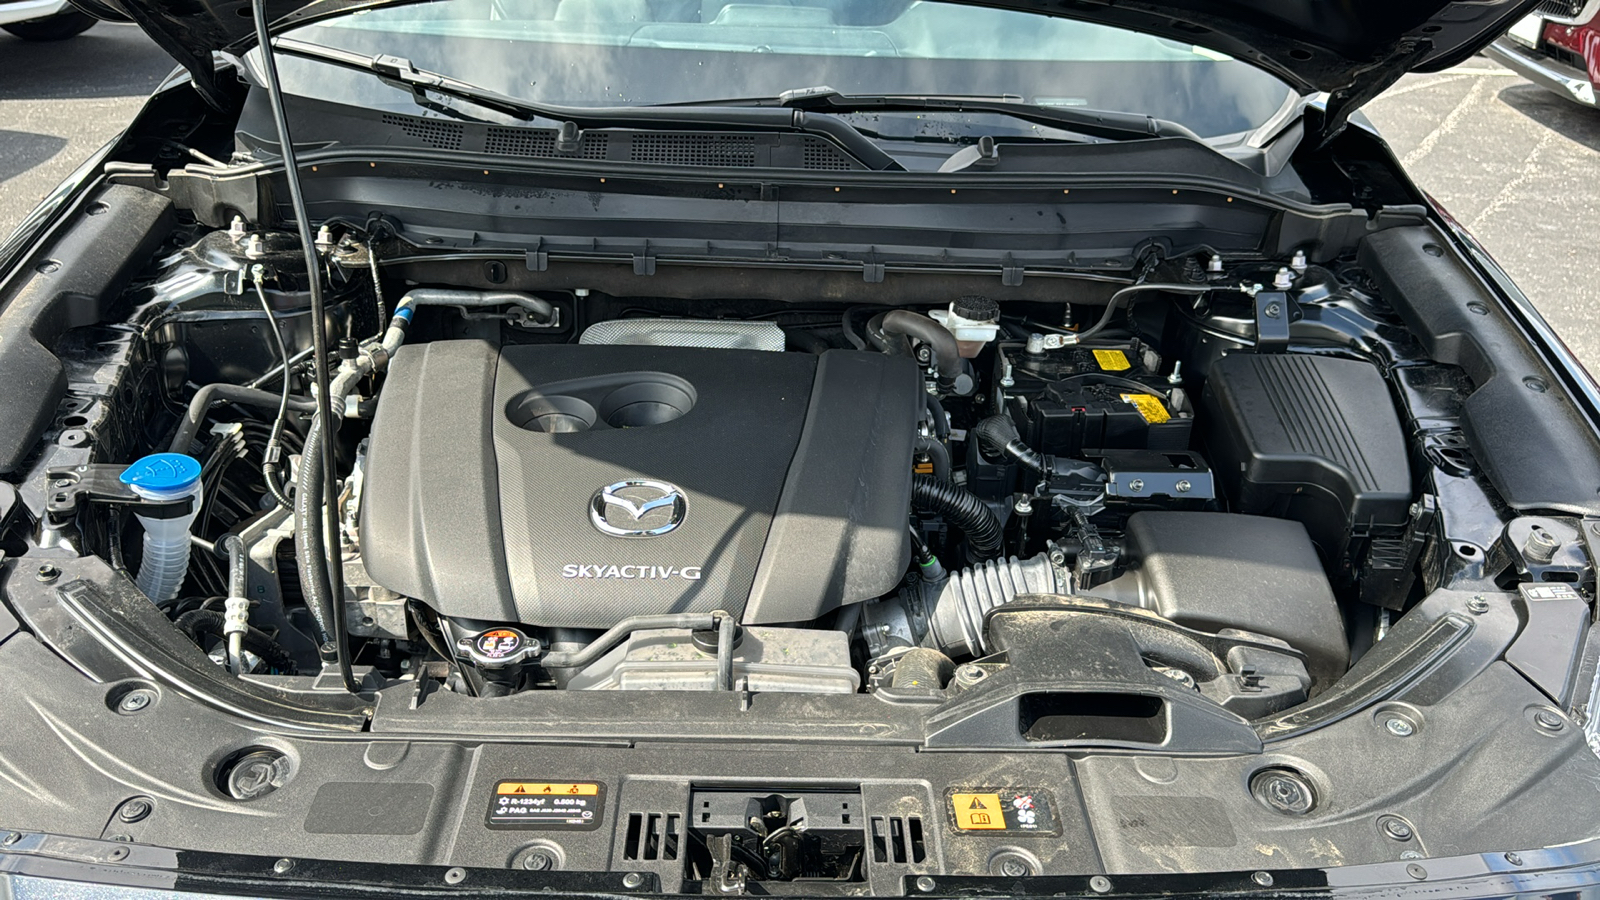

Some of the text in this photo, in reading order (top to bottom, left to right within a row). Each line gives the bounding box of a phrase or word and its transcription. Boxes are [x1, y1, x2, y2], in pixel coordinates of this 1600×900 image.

[562, 563, 702, 580] SKYACTIV-G
[510, 798, 546, 806] R-1234yf
[575, 798, 587, 806] kg
